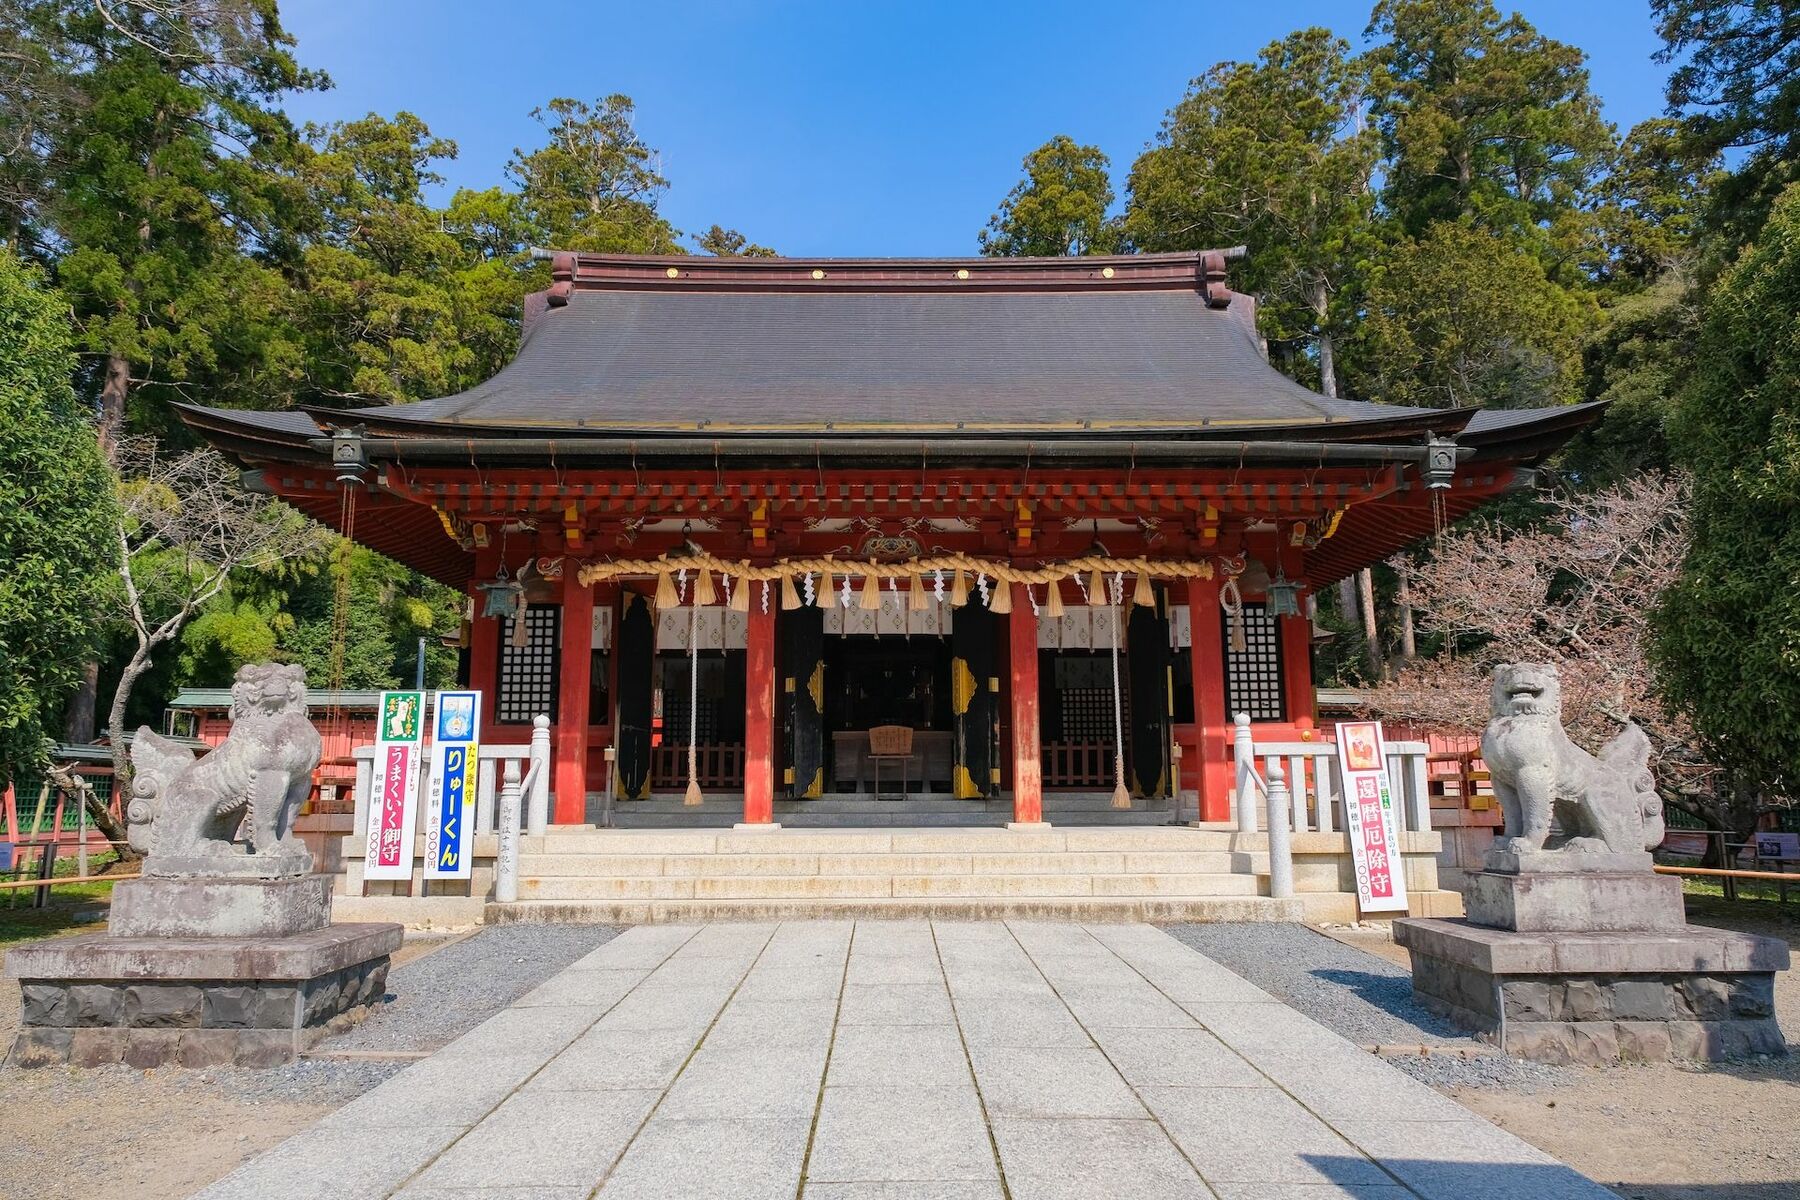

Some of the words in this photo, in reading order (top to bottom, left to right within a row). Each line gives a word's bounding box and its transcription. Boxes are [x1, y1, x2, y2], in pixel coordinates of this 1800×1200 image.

[381, 747, 402, 862] うまくいく御守
[440, 750, 461, 867] りゅーくん
[1358, 779, 1390, 893] 還暦厄除守
